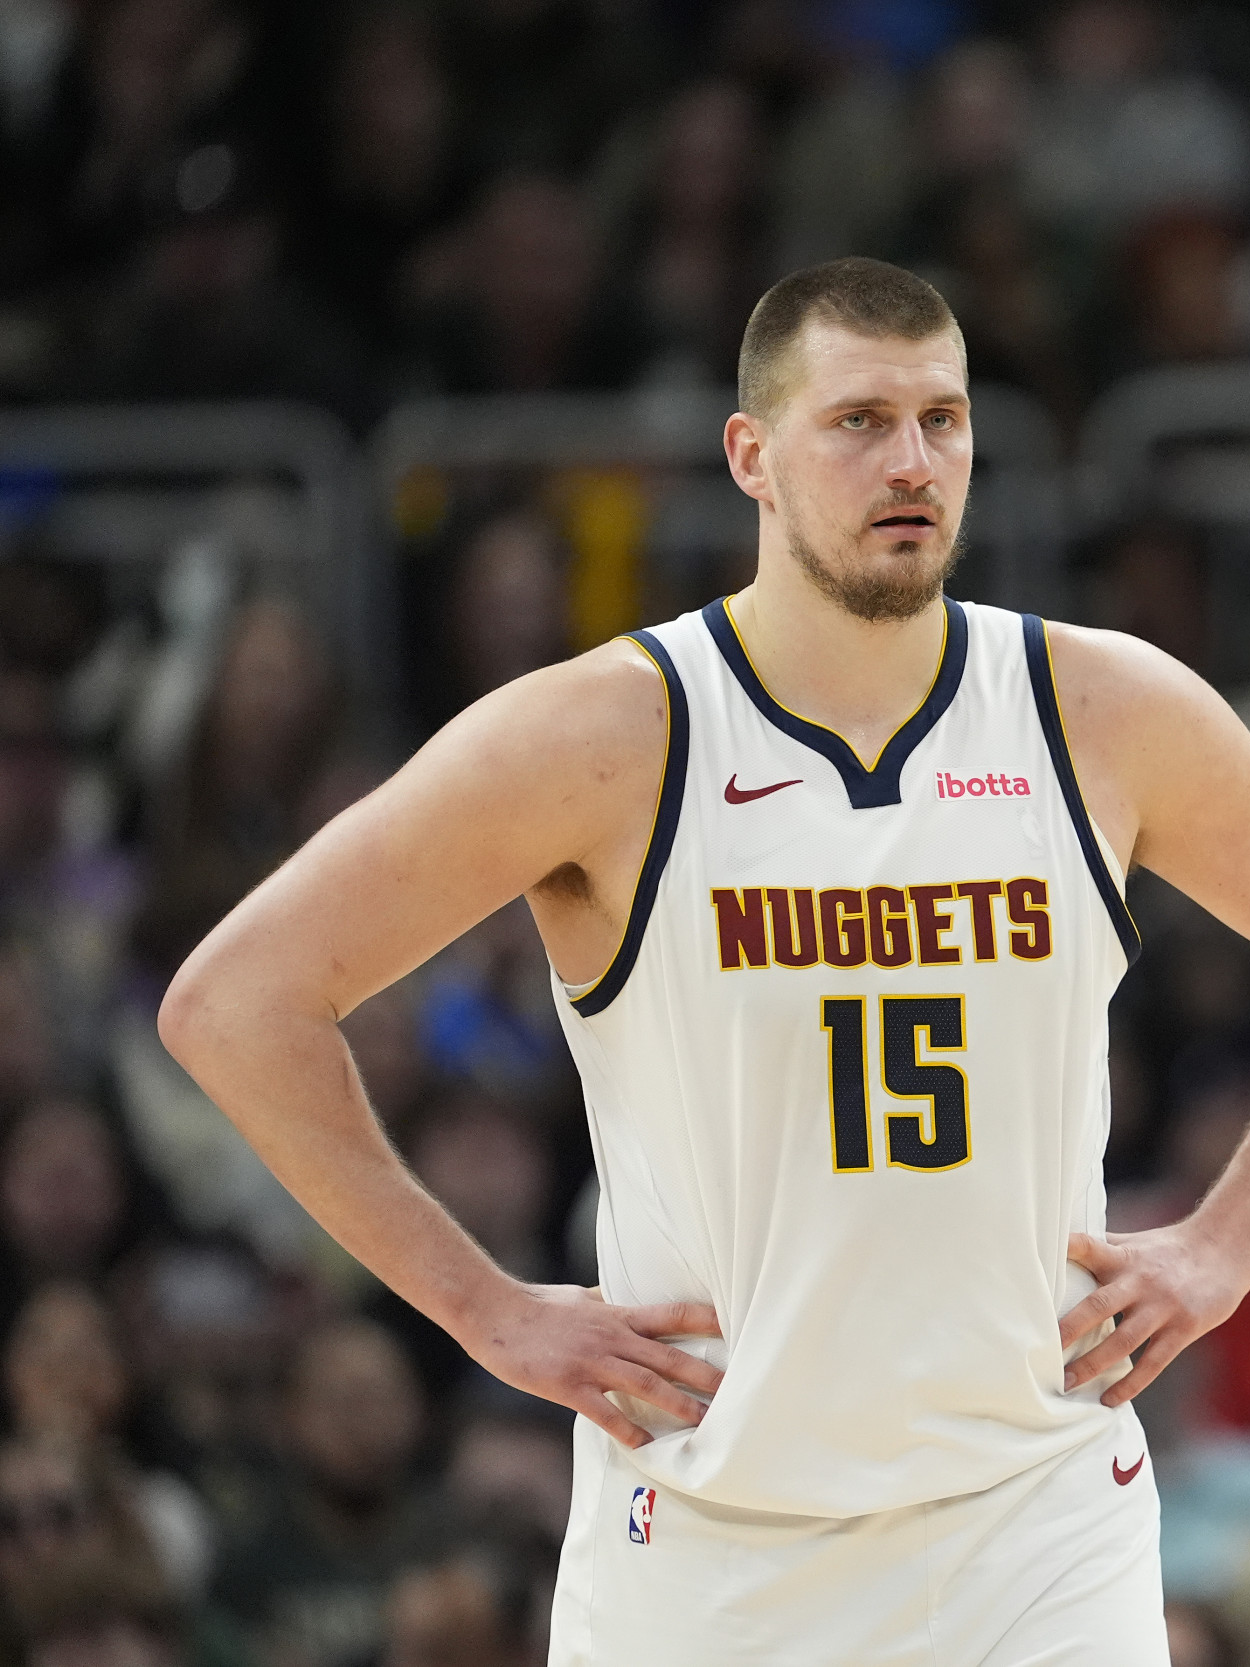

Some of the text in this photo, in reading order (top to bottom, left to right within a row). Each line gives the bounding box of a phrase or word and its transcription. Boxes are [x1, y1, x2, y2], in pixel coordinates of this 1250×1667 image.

[936, 772, 1031, 798] ibotta
[710, 876, 1052, 971] NUGGETS
[820, 993, 972, 1174] 15
